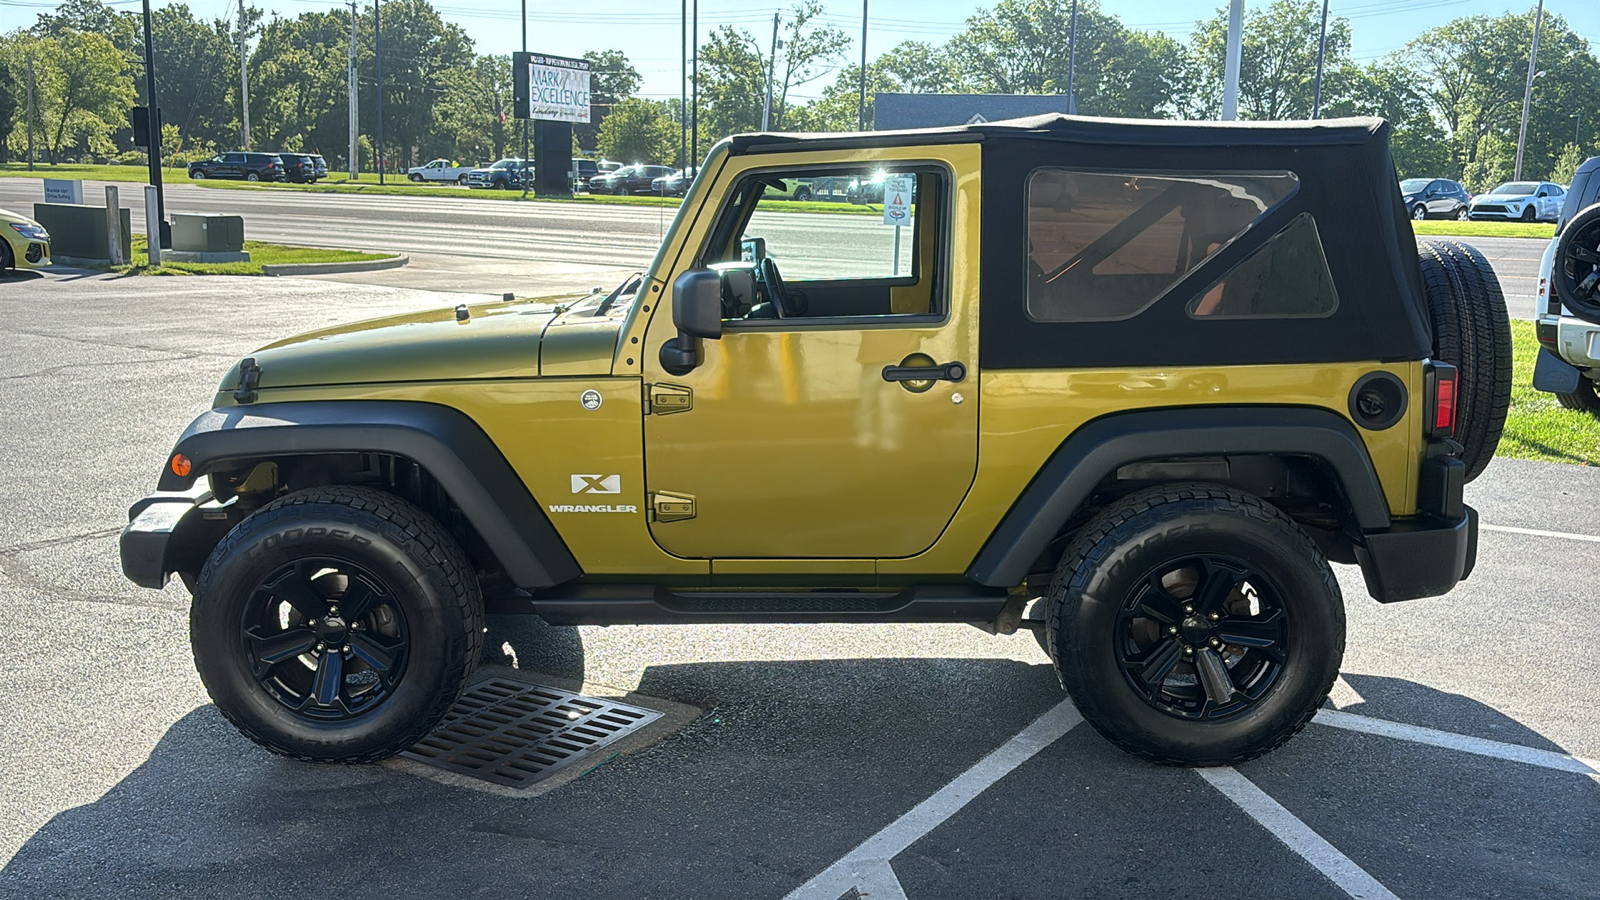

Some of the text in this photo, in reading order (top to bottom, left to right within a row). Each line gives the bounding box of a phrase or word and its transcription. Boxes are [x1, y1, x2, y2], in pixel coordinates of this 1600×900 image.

[532, 69, 559, 87] MARK
[532, 86, 588, 107] EXCELLENCE
[549, 505, 638, 513] WRANGLER
